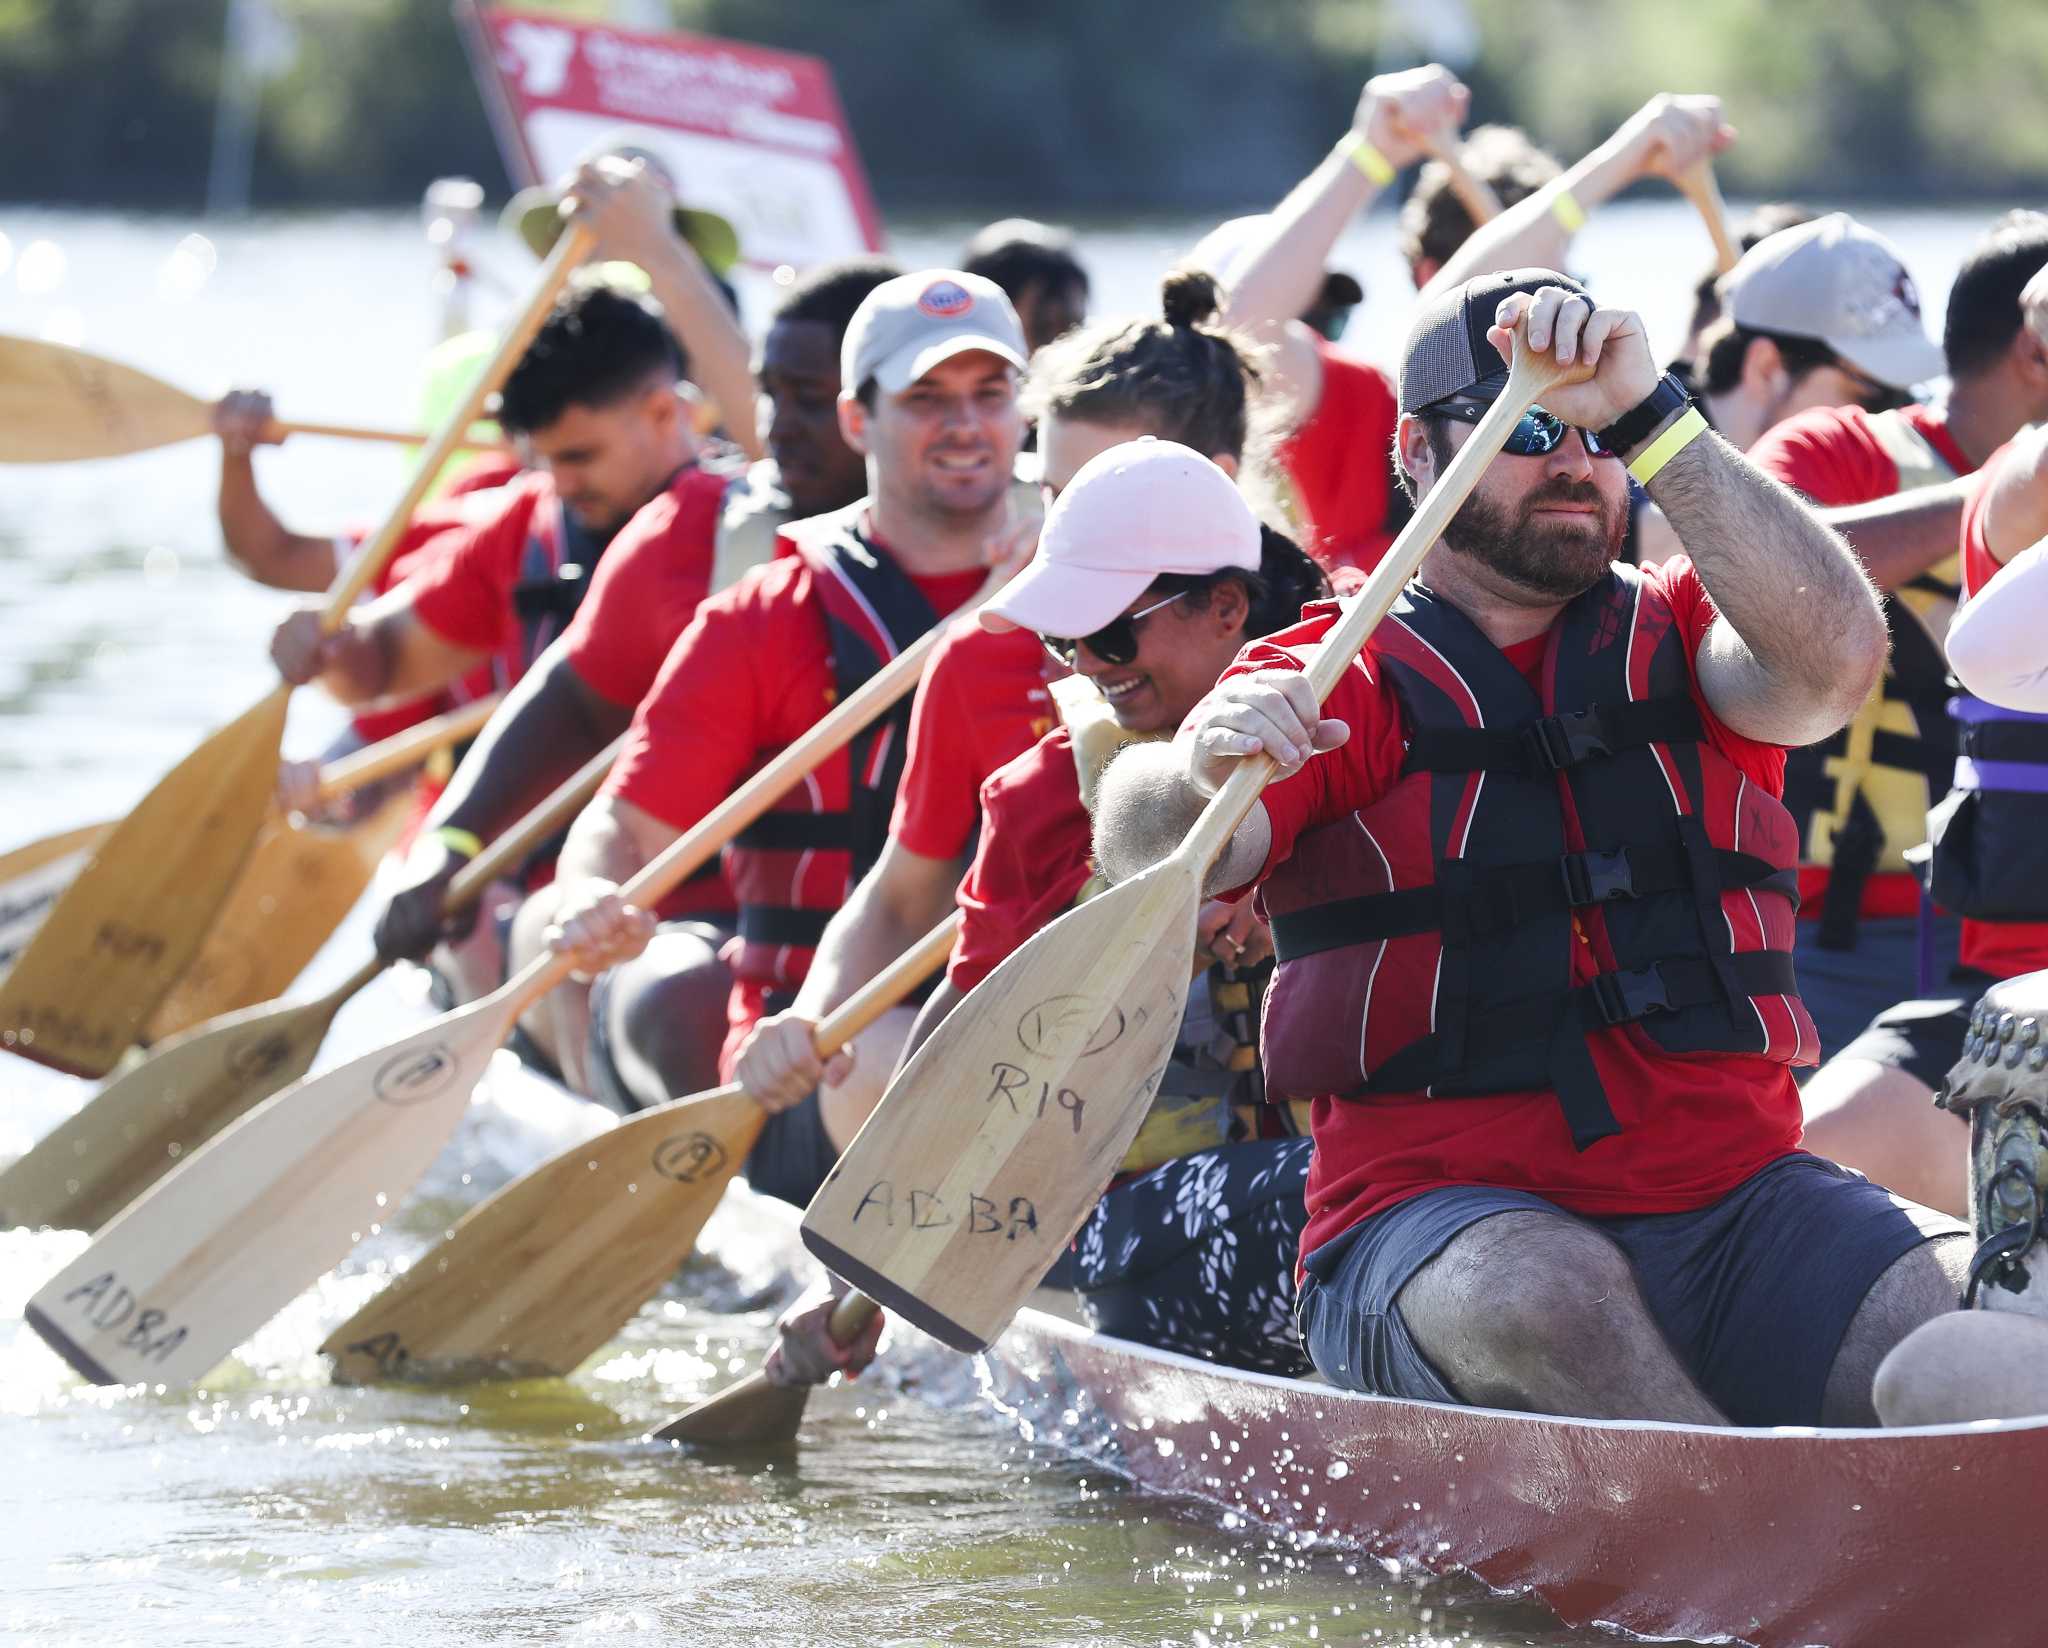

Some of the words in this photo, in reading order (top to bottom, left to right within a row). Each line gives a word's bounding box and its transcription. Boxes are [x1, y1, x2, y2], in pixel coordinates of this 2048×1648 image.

[1749, 805, 1783, 850] XL
[986, 1062, 1085, 1135] R19
[852, 1180, 1039, 1241] ADBA
[64, 1272, 188, 1364] ADBA
